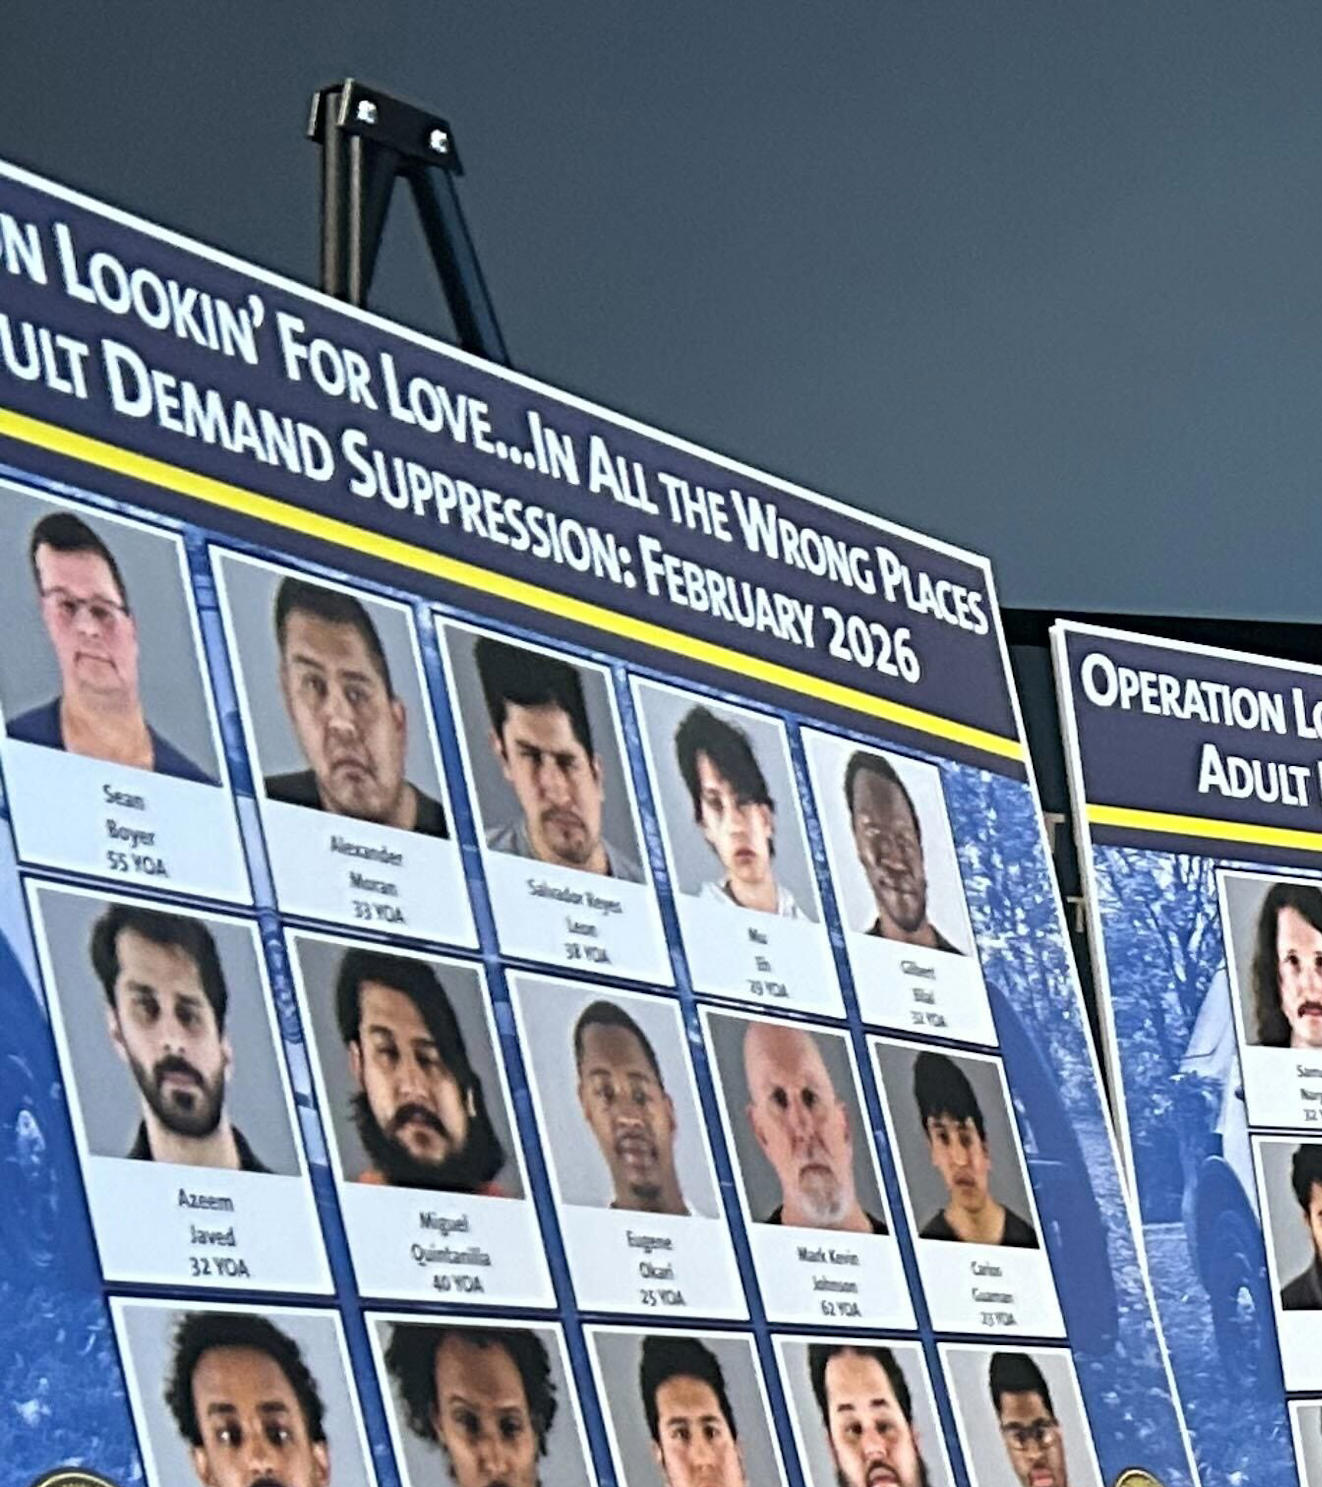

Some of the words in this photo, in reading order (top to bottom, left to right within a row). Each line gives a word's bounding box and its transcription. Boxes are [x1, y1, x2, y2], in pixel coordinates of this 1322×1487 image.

[0, 212, 48, 285] N
[278, 311, 378, 410] FOR
[589, 436, 659, 516] ALL
[659, 472, 733, 542] THE
[731, 490, 877, 594] WRONG
[875, 546, 989, 634] PLACES
[101, 339, 335, 482] DEMAND
[342, 430, 637, 589] SUPPRESSION:
[638, 534, 815, 648] FEBRUARY
[822, 607, 921, 683] 2026
[1081, 653, 1286, 735] OPERATION
[1198, 743, 1312, 807] ADULT
[103, 784, 145, 811] Sean
[106, 819, 155, 848] Boyer
[107, 850, 129, 872] 55
[132, 854, 169, 878] YOA
[352, 900, 373, 920] 33
[374, 905, 406, 924] YOA
[584, 946, 612, 964] YOA
[179, 1188, 234, 1212] Azeem
[191, 1225, 237, 1247] Javed
[419, 1212, 470, 1237] Miguel
[190, 1257, 211, 1276] 32
[213, 1258, 250, 1278] YOA
[453, 1275, 484, 1293] YOA
[658, 1290, 686, 1306] YOA
[837, 1302, 862, 1317] YOA
